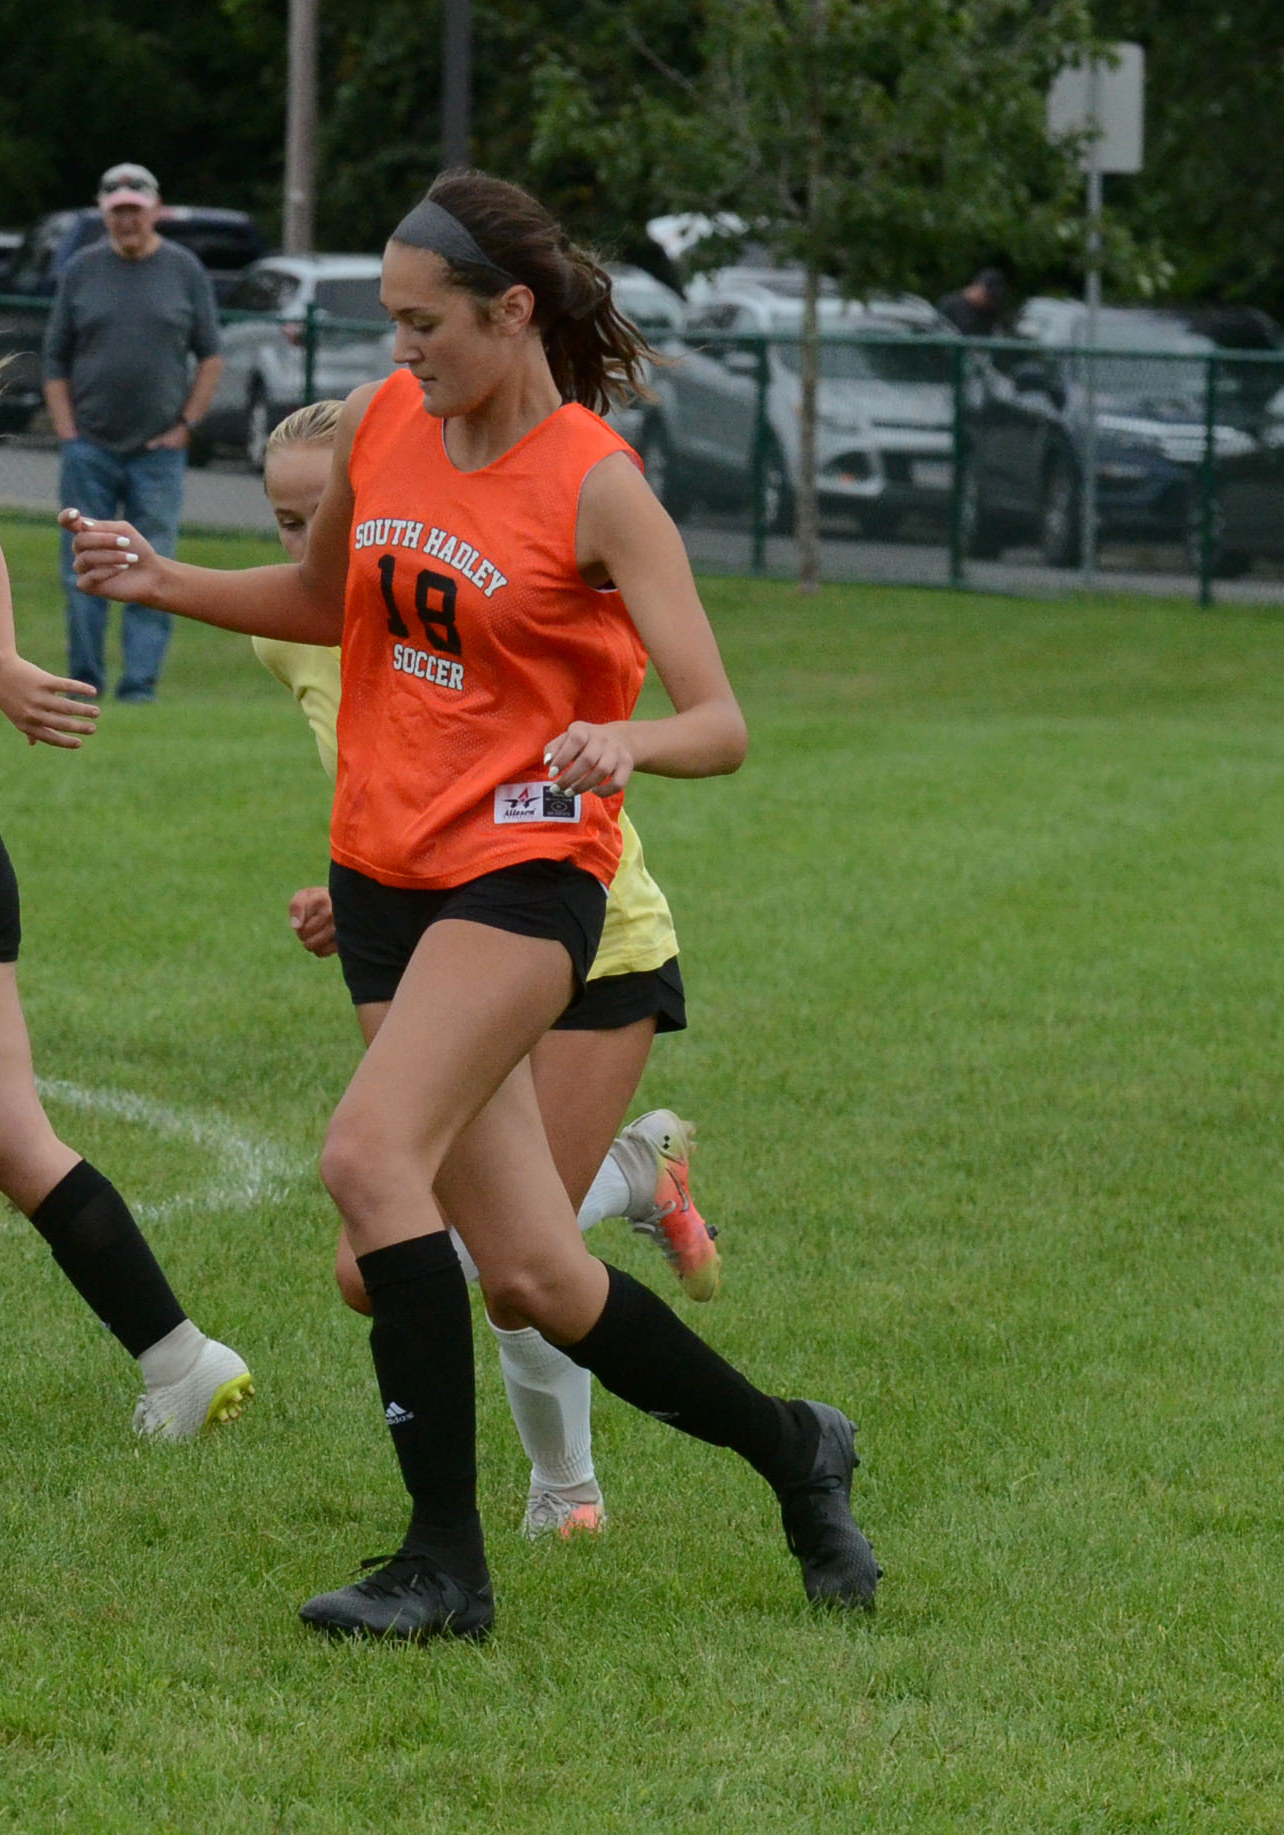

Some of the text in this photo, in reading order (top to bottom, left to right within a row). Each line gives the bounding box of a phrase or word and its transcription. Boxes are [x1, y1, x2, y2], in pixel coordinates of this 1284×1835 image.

[354, 518, 509, 598] SOUTH HADLEY
[377, 554, 462, 656] 18
[393, 643, 465, 691] SOCCER
